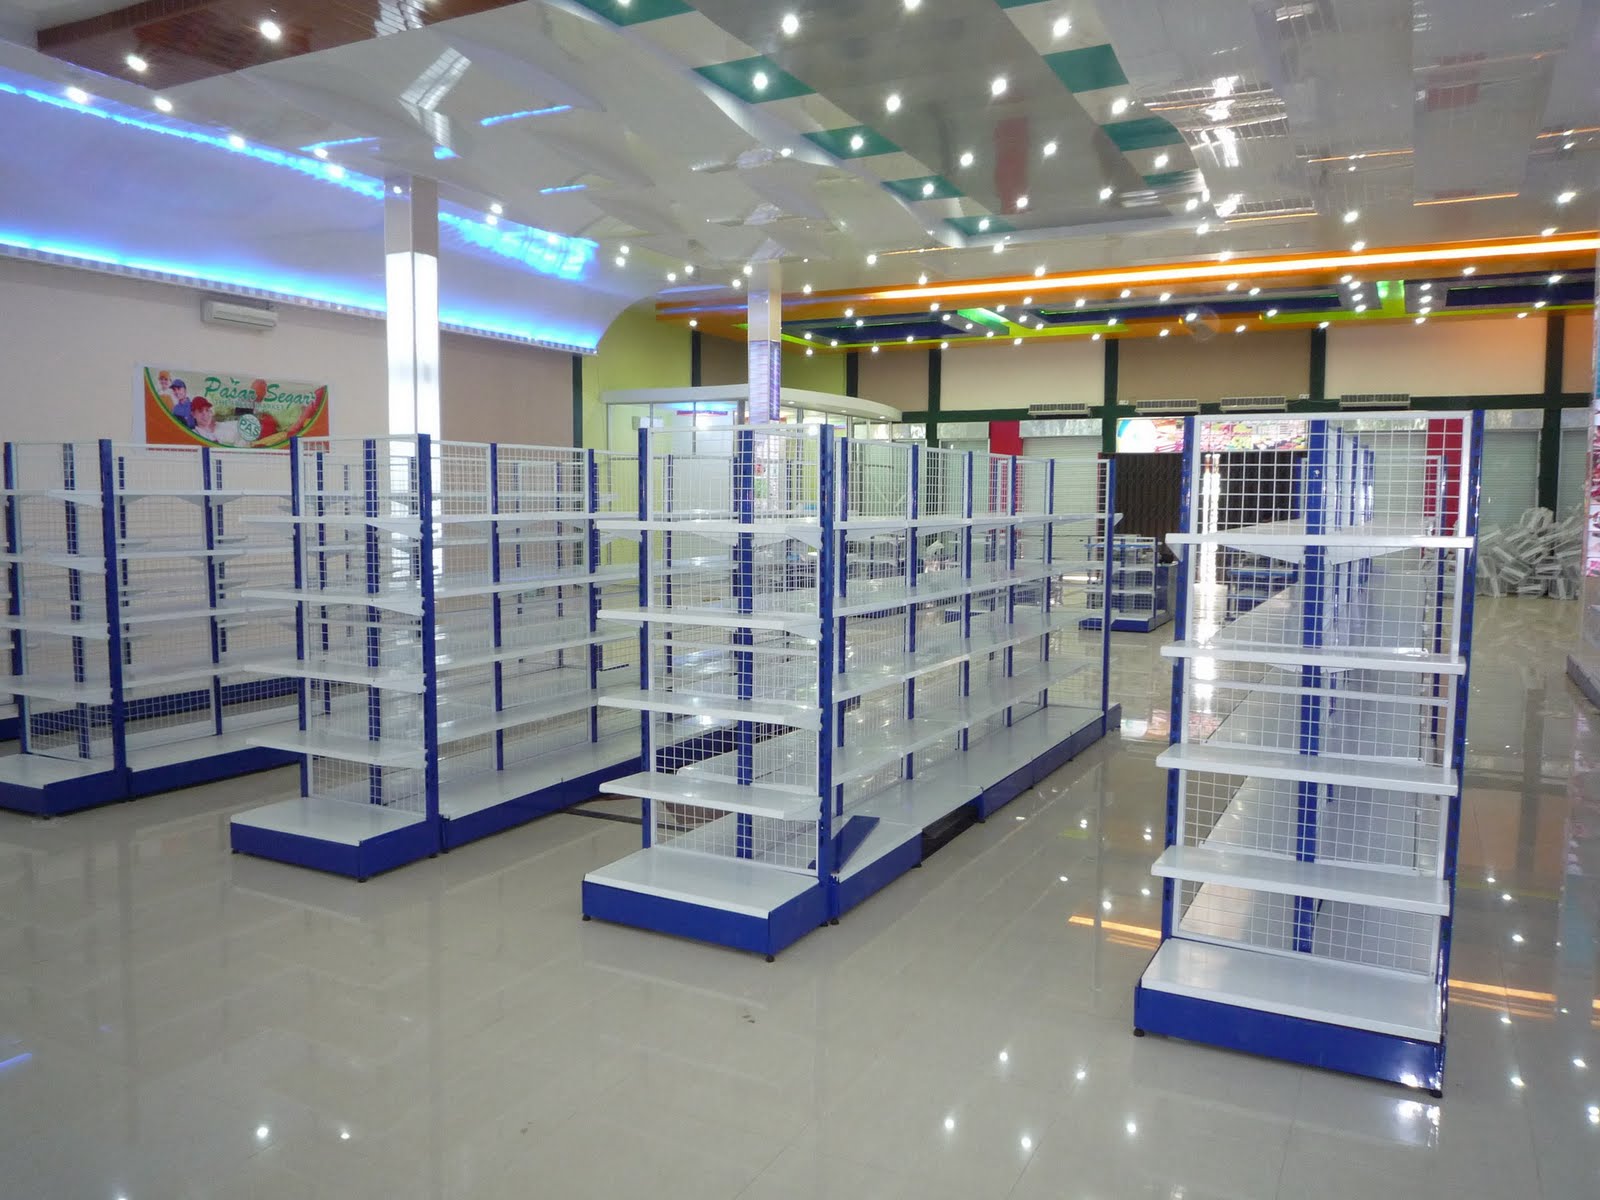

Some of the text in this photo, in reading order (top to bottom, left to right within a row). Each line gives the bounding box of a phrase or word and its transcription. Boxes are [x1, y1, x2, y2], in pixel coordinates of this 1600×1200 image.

[204, 377, 315, 409] Pasar Segar
[240, 418, 260, 437] PAS
